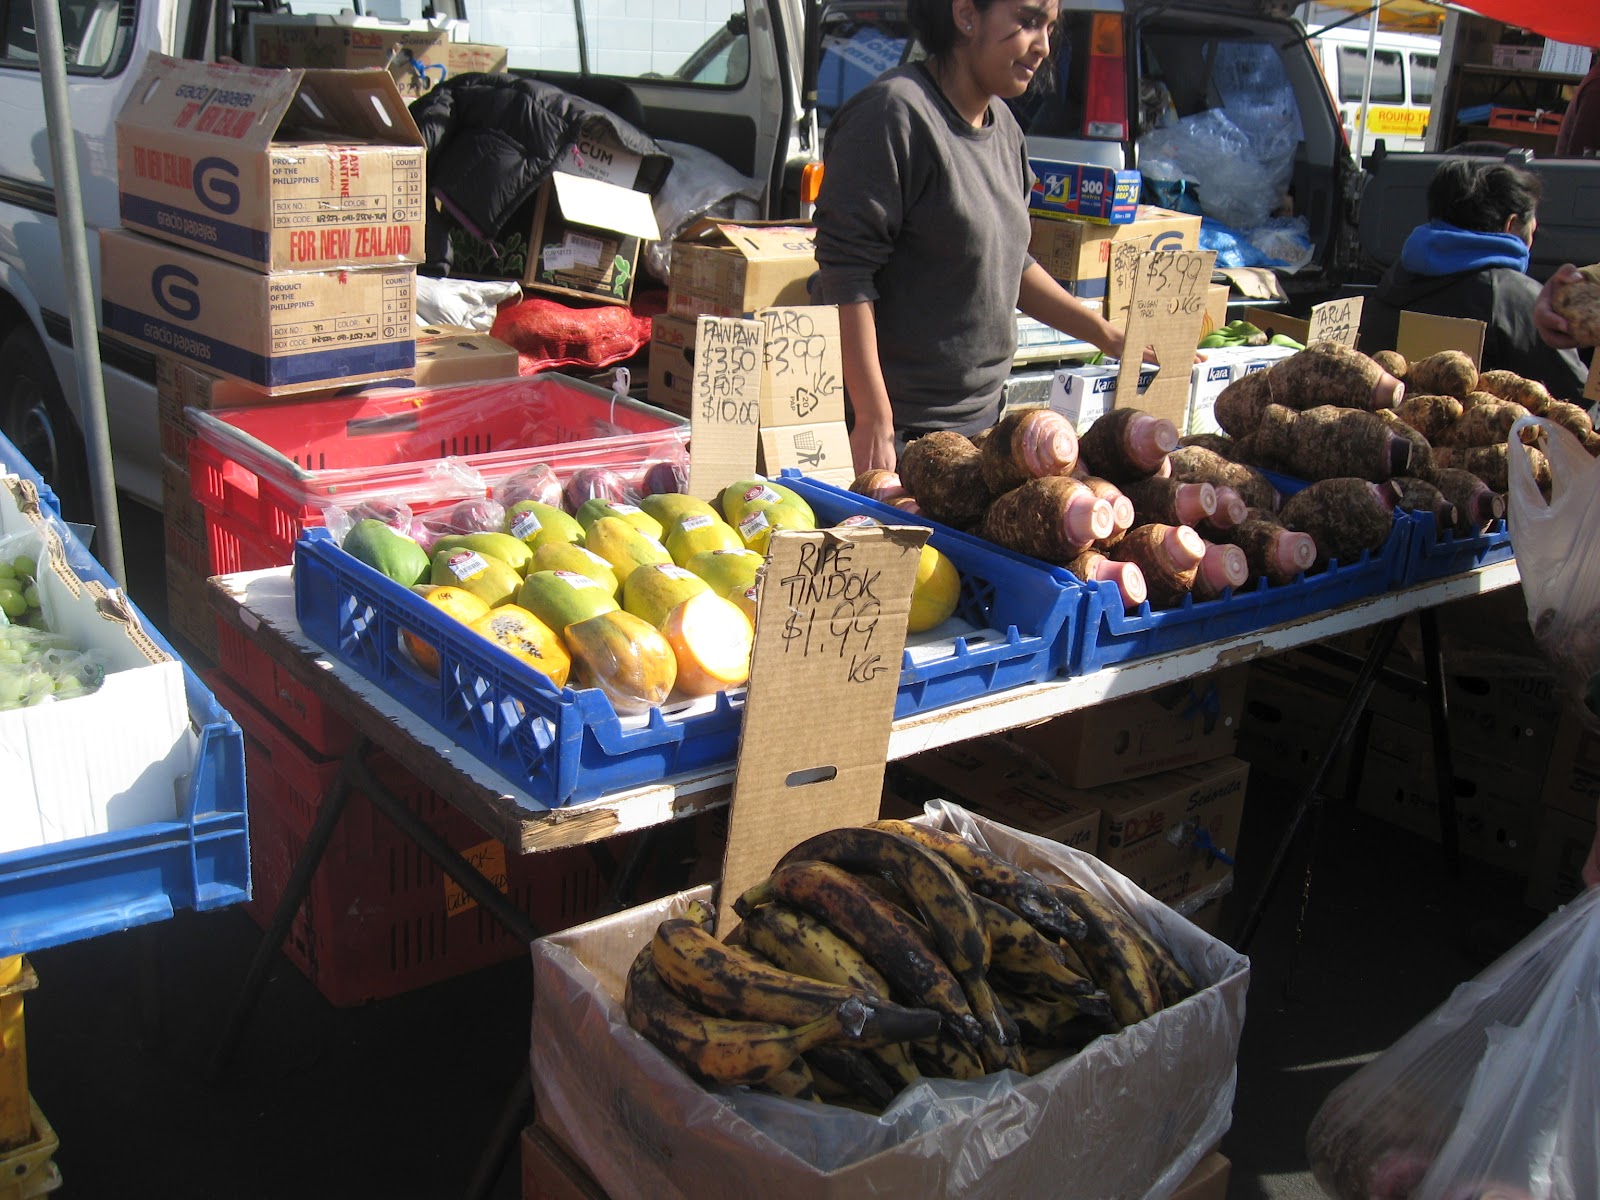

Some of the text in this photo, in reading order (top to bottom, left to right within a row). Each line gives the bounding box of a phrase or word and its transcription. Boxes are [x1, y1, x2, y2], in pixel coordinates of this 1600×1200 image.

[352, 32, 384, 46] Dole
[1379, 110, 1415, 122] ROUND
[579, 141, 613, 166] CUM
[395, 158, 417, 166] COUNT
[284, 167, 298, 175] THE
[410, 171, 419, 180] 10
[272, 176, 319, 186] PHILIPPINES
[397, 184, 419, 193] 6 12
[1081, 179, 1103, 195] 300
[397, 197, 419, 206] 8 14
[276, 216, 291, 224] BOX
[293, 215, 313, 223] CODE:
[409, 210, 419, 218] 16
[156, 212, 218, 242] Gracio papayas
[289, 225, 411, 262] FOR NEW ZEALAND
[1147, 253, 1203, 296] $3.99
[270, 282, 302, 292] PRODUCT
[399, 289, 407, 297] 10
[270, 292, 295, 301] OF THE
[1182, 293, 1205, 315] KG
[270, 300, 315, 311] PHILIPPINES
[387, 301, 407, 311] 6 12
[387, 314, 407, 324] 8 14
[1316, 302, 1351, 326] TARUA
[274, 327, 288, 336] BOX
[399, 326, 407, 334] 16
[760, 310, 814, 338] TARO
[143, 322, 212, 359] Gracio papayas
[655, 323, 684, 344] Dole
[703, 319, 760, 347] PAWPAW
[274, 340, 288, 349] BOX
[289, 338, 309, 347] CODE:
[702, 341, 756, 375] $3.50
[762, 334, 827, 377] $3.99
[1208, 366, 1230, 381] kara
[813, 371, 843, 397] KG
[1094, 376, 1116, 394] kara
[702, 395, 760, 425] $10.00
[801, 397, 809, 408] 20
[797, 542, 855, 577] RIPE
[780, 568, 882, 607] TINDOK
[781, 599, 881, 658] $1.99
[847, 654, 889, 683] KG
[1123, 810, 1165, 840] Dole
